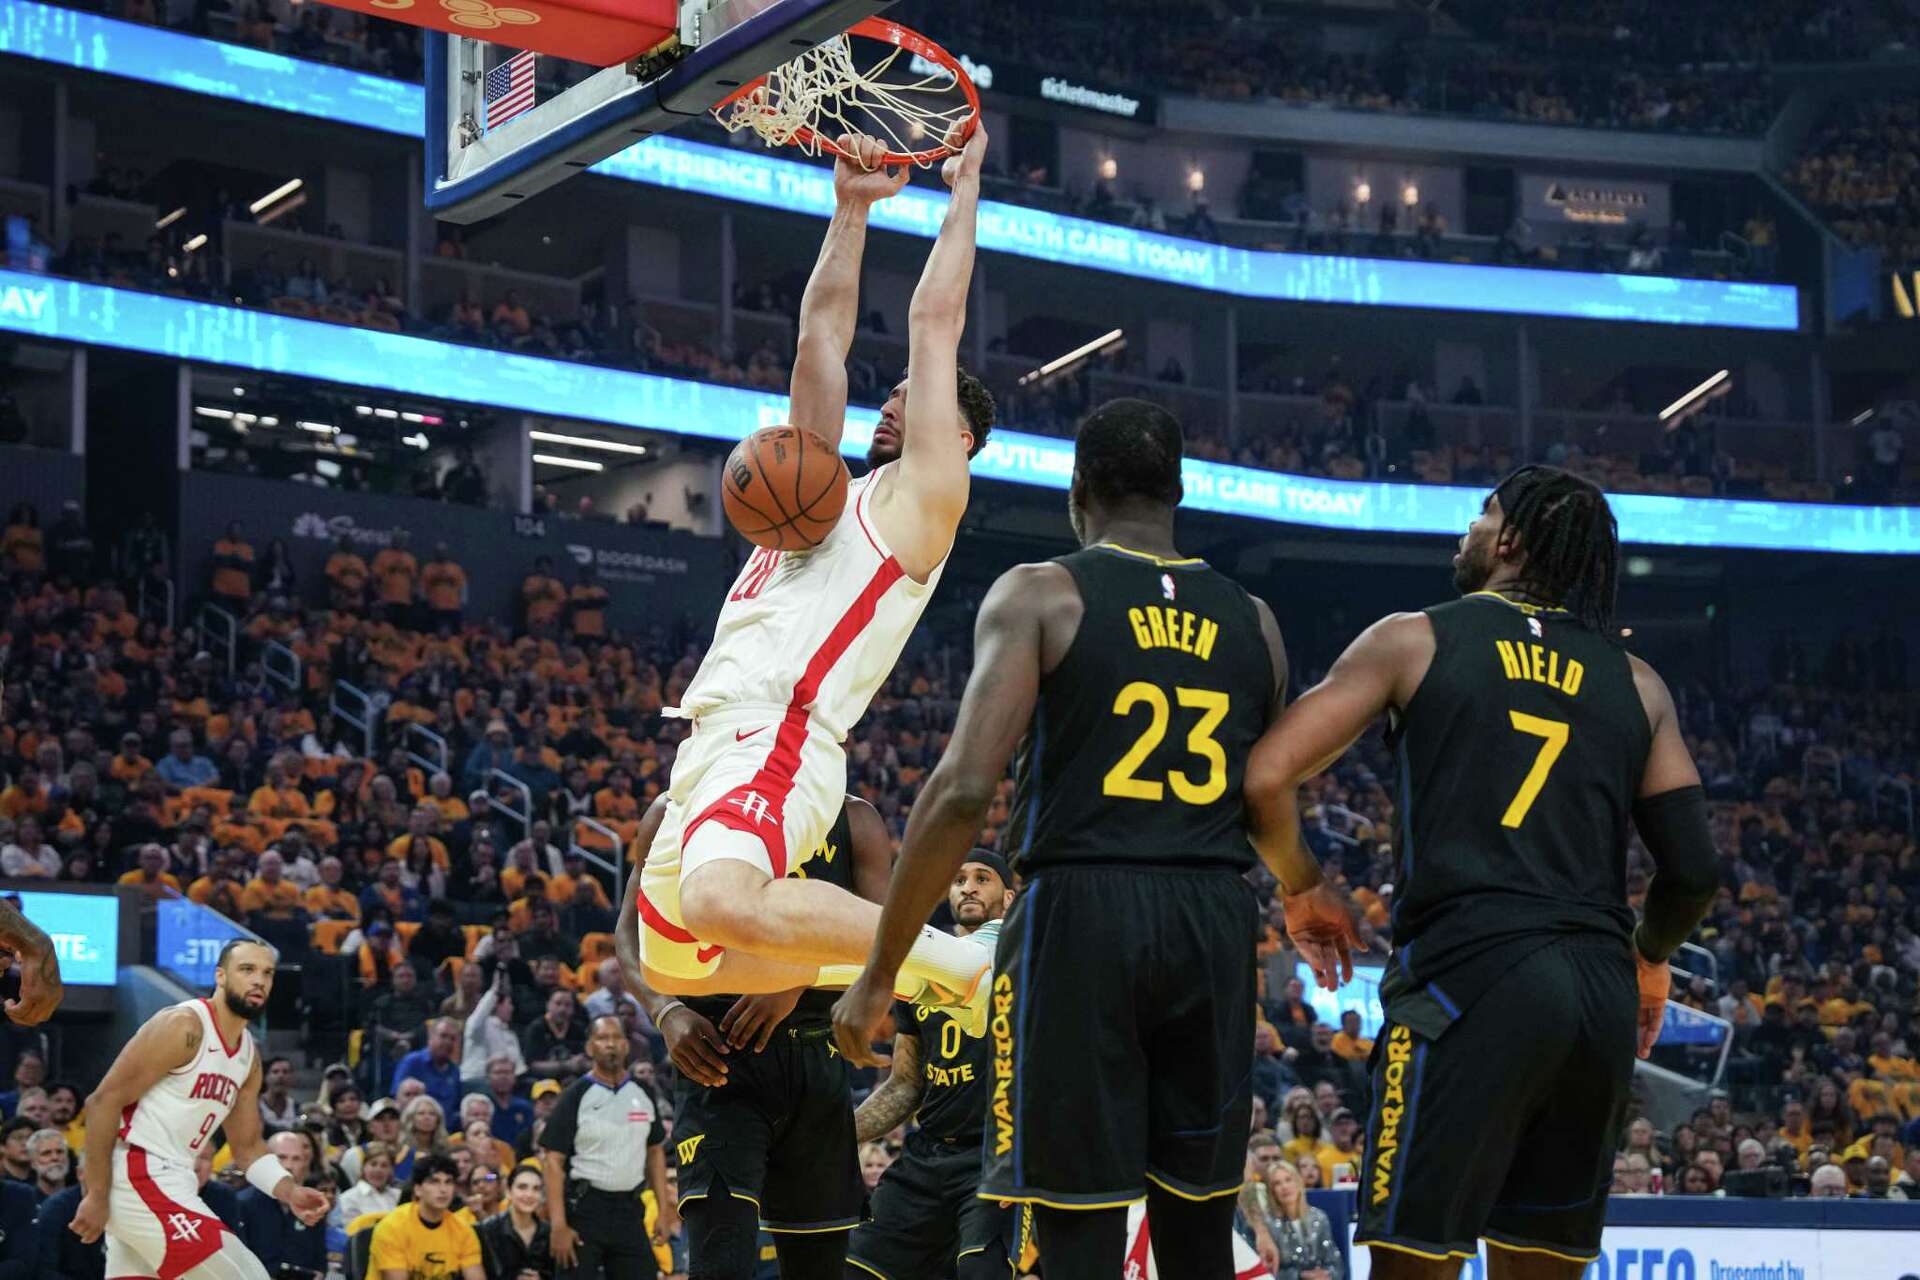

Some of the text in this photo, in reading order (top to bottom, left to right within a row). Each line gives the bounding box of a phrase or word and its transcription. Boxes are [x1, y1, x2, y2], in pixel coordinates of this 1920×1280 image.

[775, 169, 829, 203] THE
[1067, 229, 1131, 262] CARE
[1135, 240, 1211, 275] TODAY
[1217, 476, 1281, 508] CARE
[1284, 486, 1366, 517] TODAY
[1128, 605, 1219, 661] GREEN
[1495, 640, 1584, 696] HIELD
[1103, 681, 1230, 806] 23
[1501, 709, 1570, 829] 7
[941, 1019, 961, 1060] 0
[991, 973, 1014, 1157] WARRIORS
[926, 1062, 975, 1087] STATE
[190, 1112, 216, 1150] 9
[1372, 1025, 1412, 1206] WARRIORS
